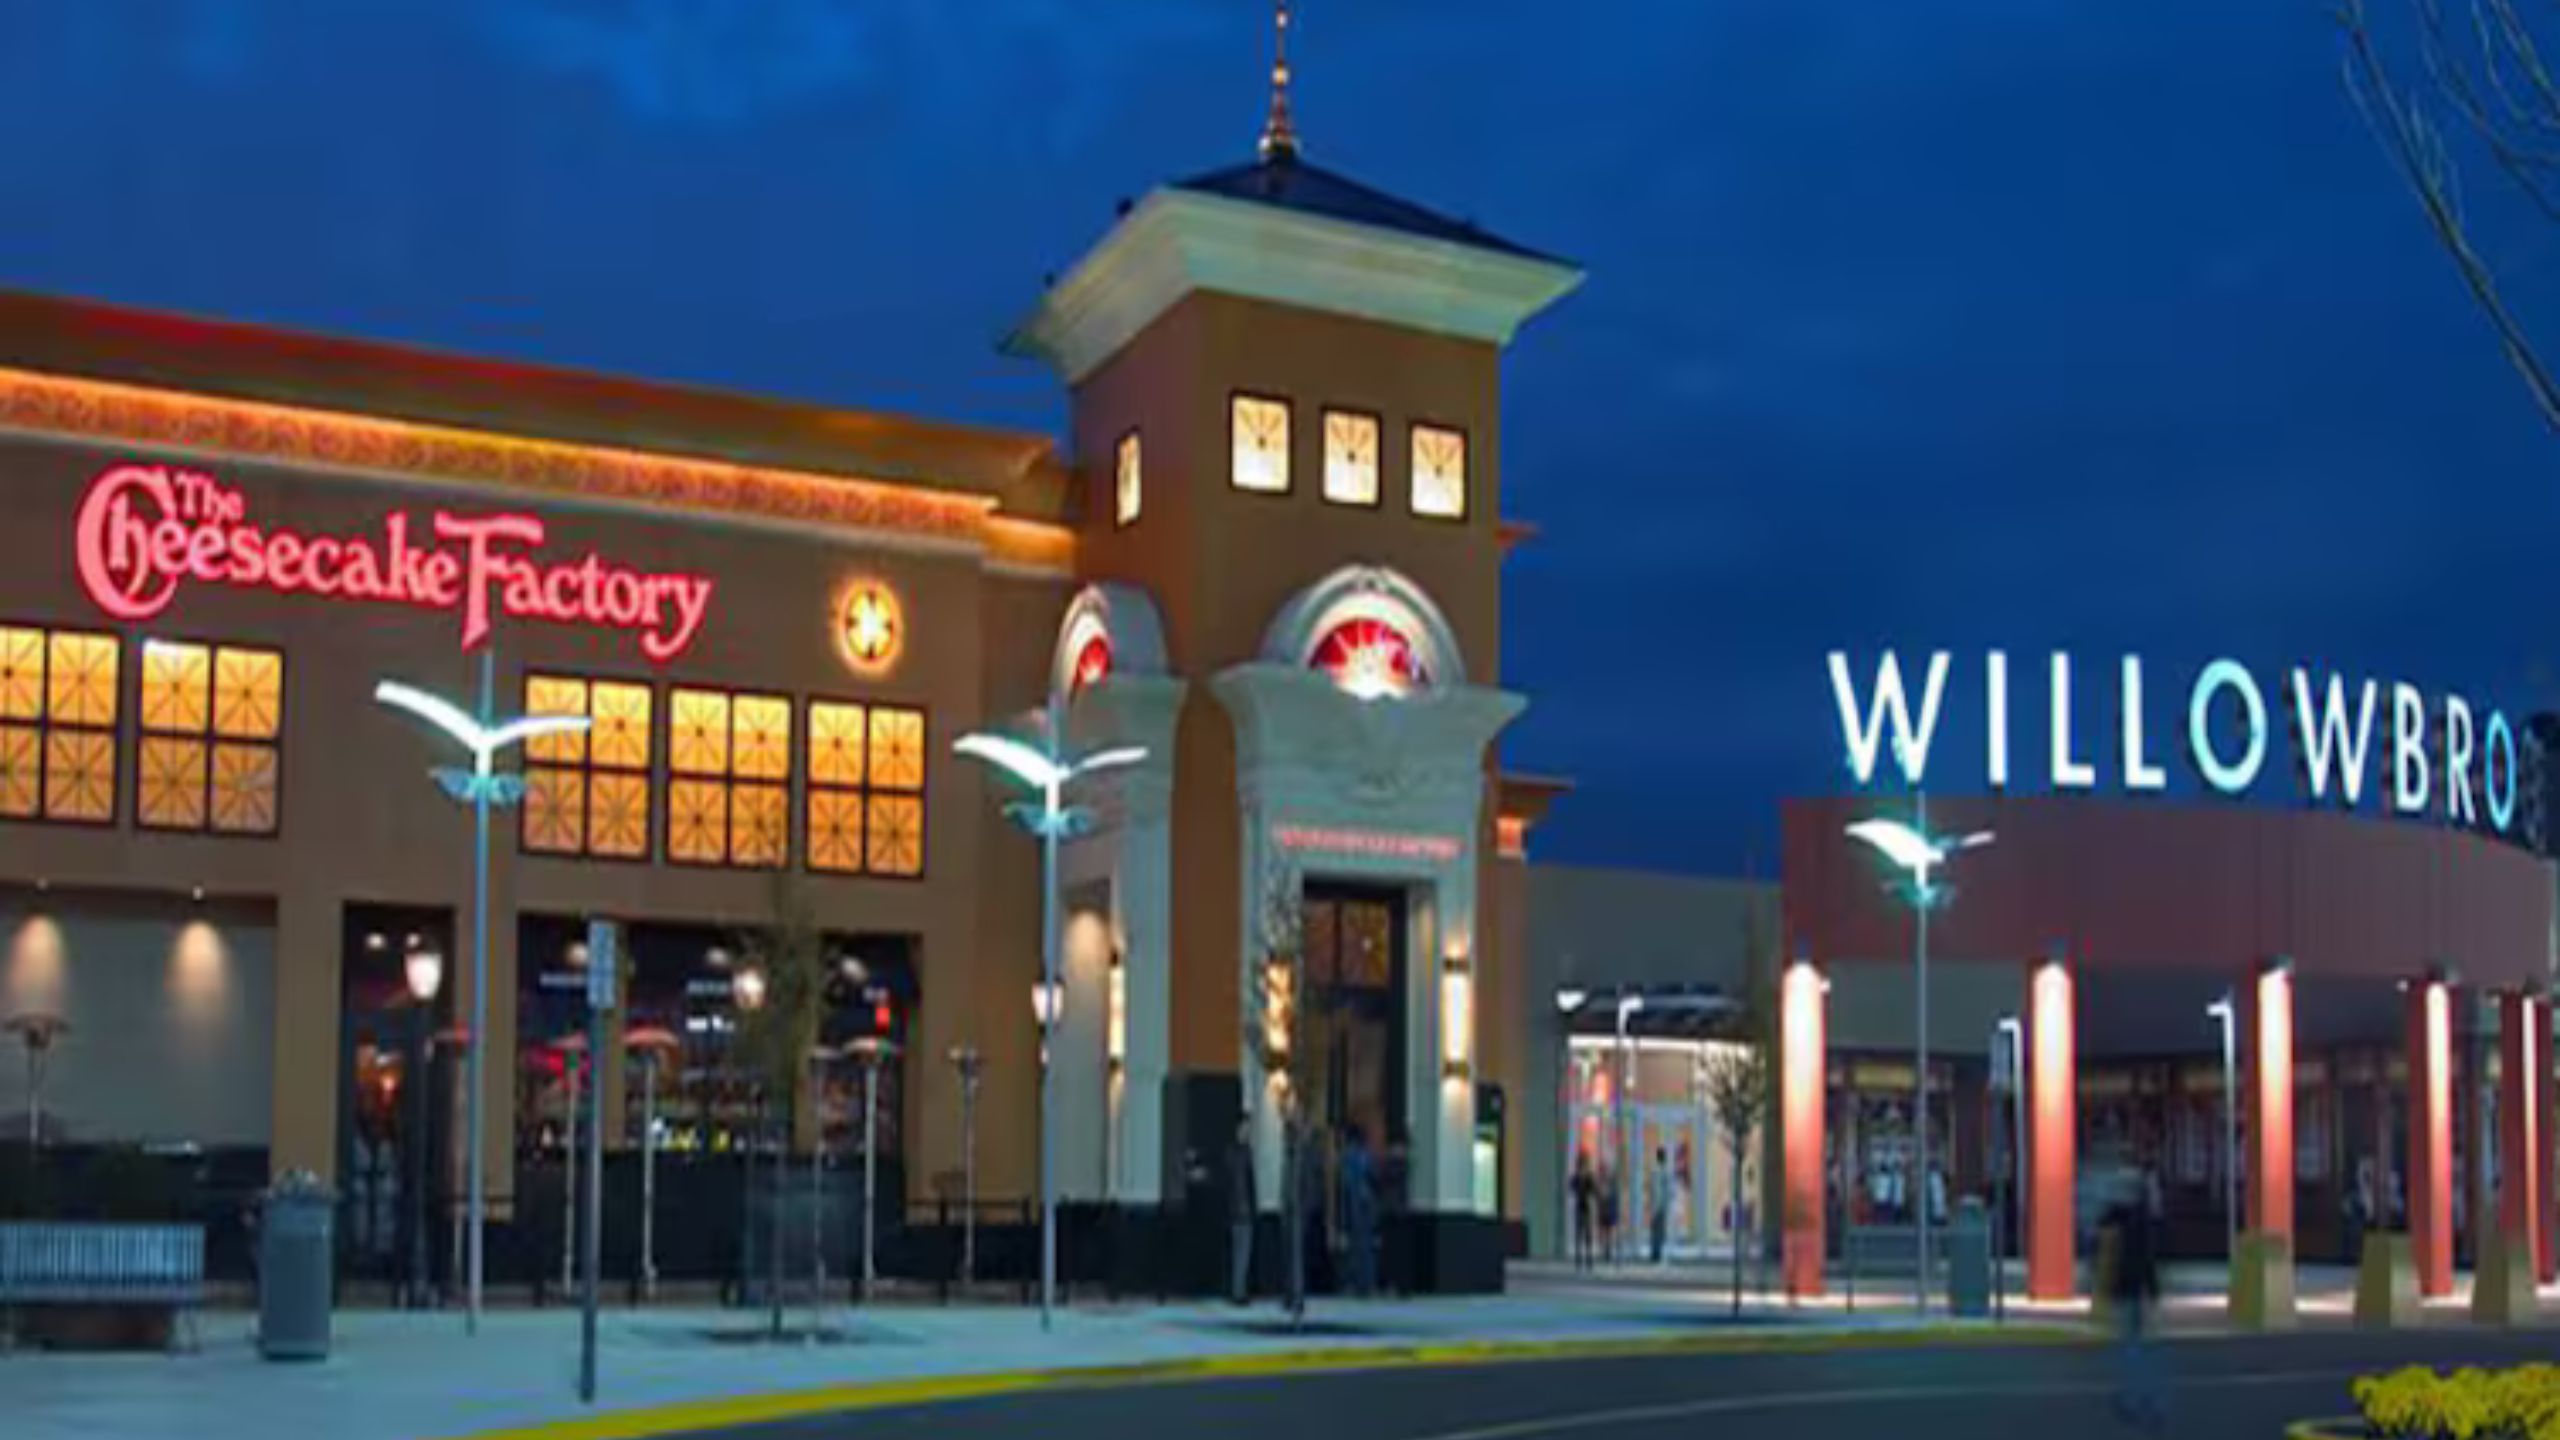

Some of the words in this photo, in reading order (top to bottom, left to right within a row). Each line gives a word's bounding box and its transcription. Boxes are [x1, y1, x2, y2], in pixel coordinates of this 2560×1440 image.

[173, 473, 245, 519] The
[77, 464, 461, 618] Cheesecake
[434, 512, 713, 659] Factory
